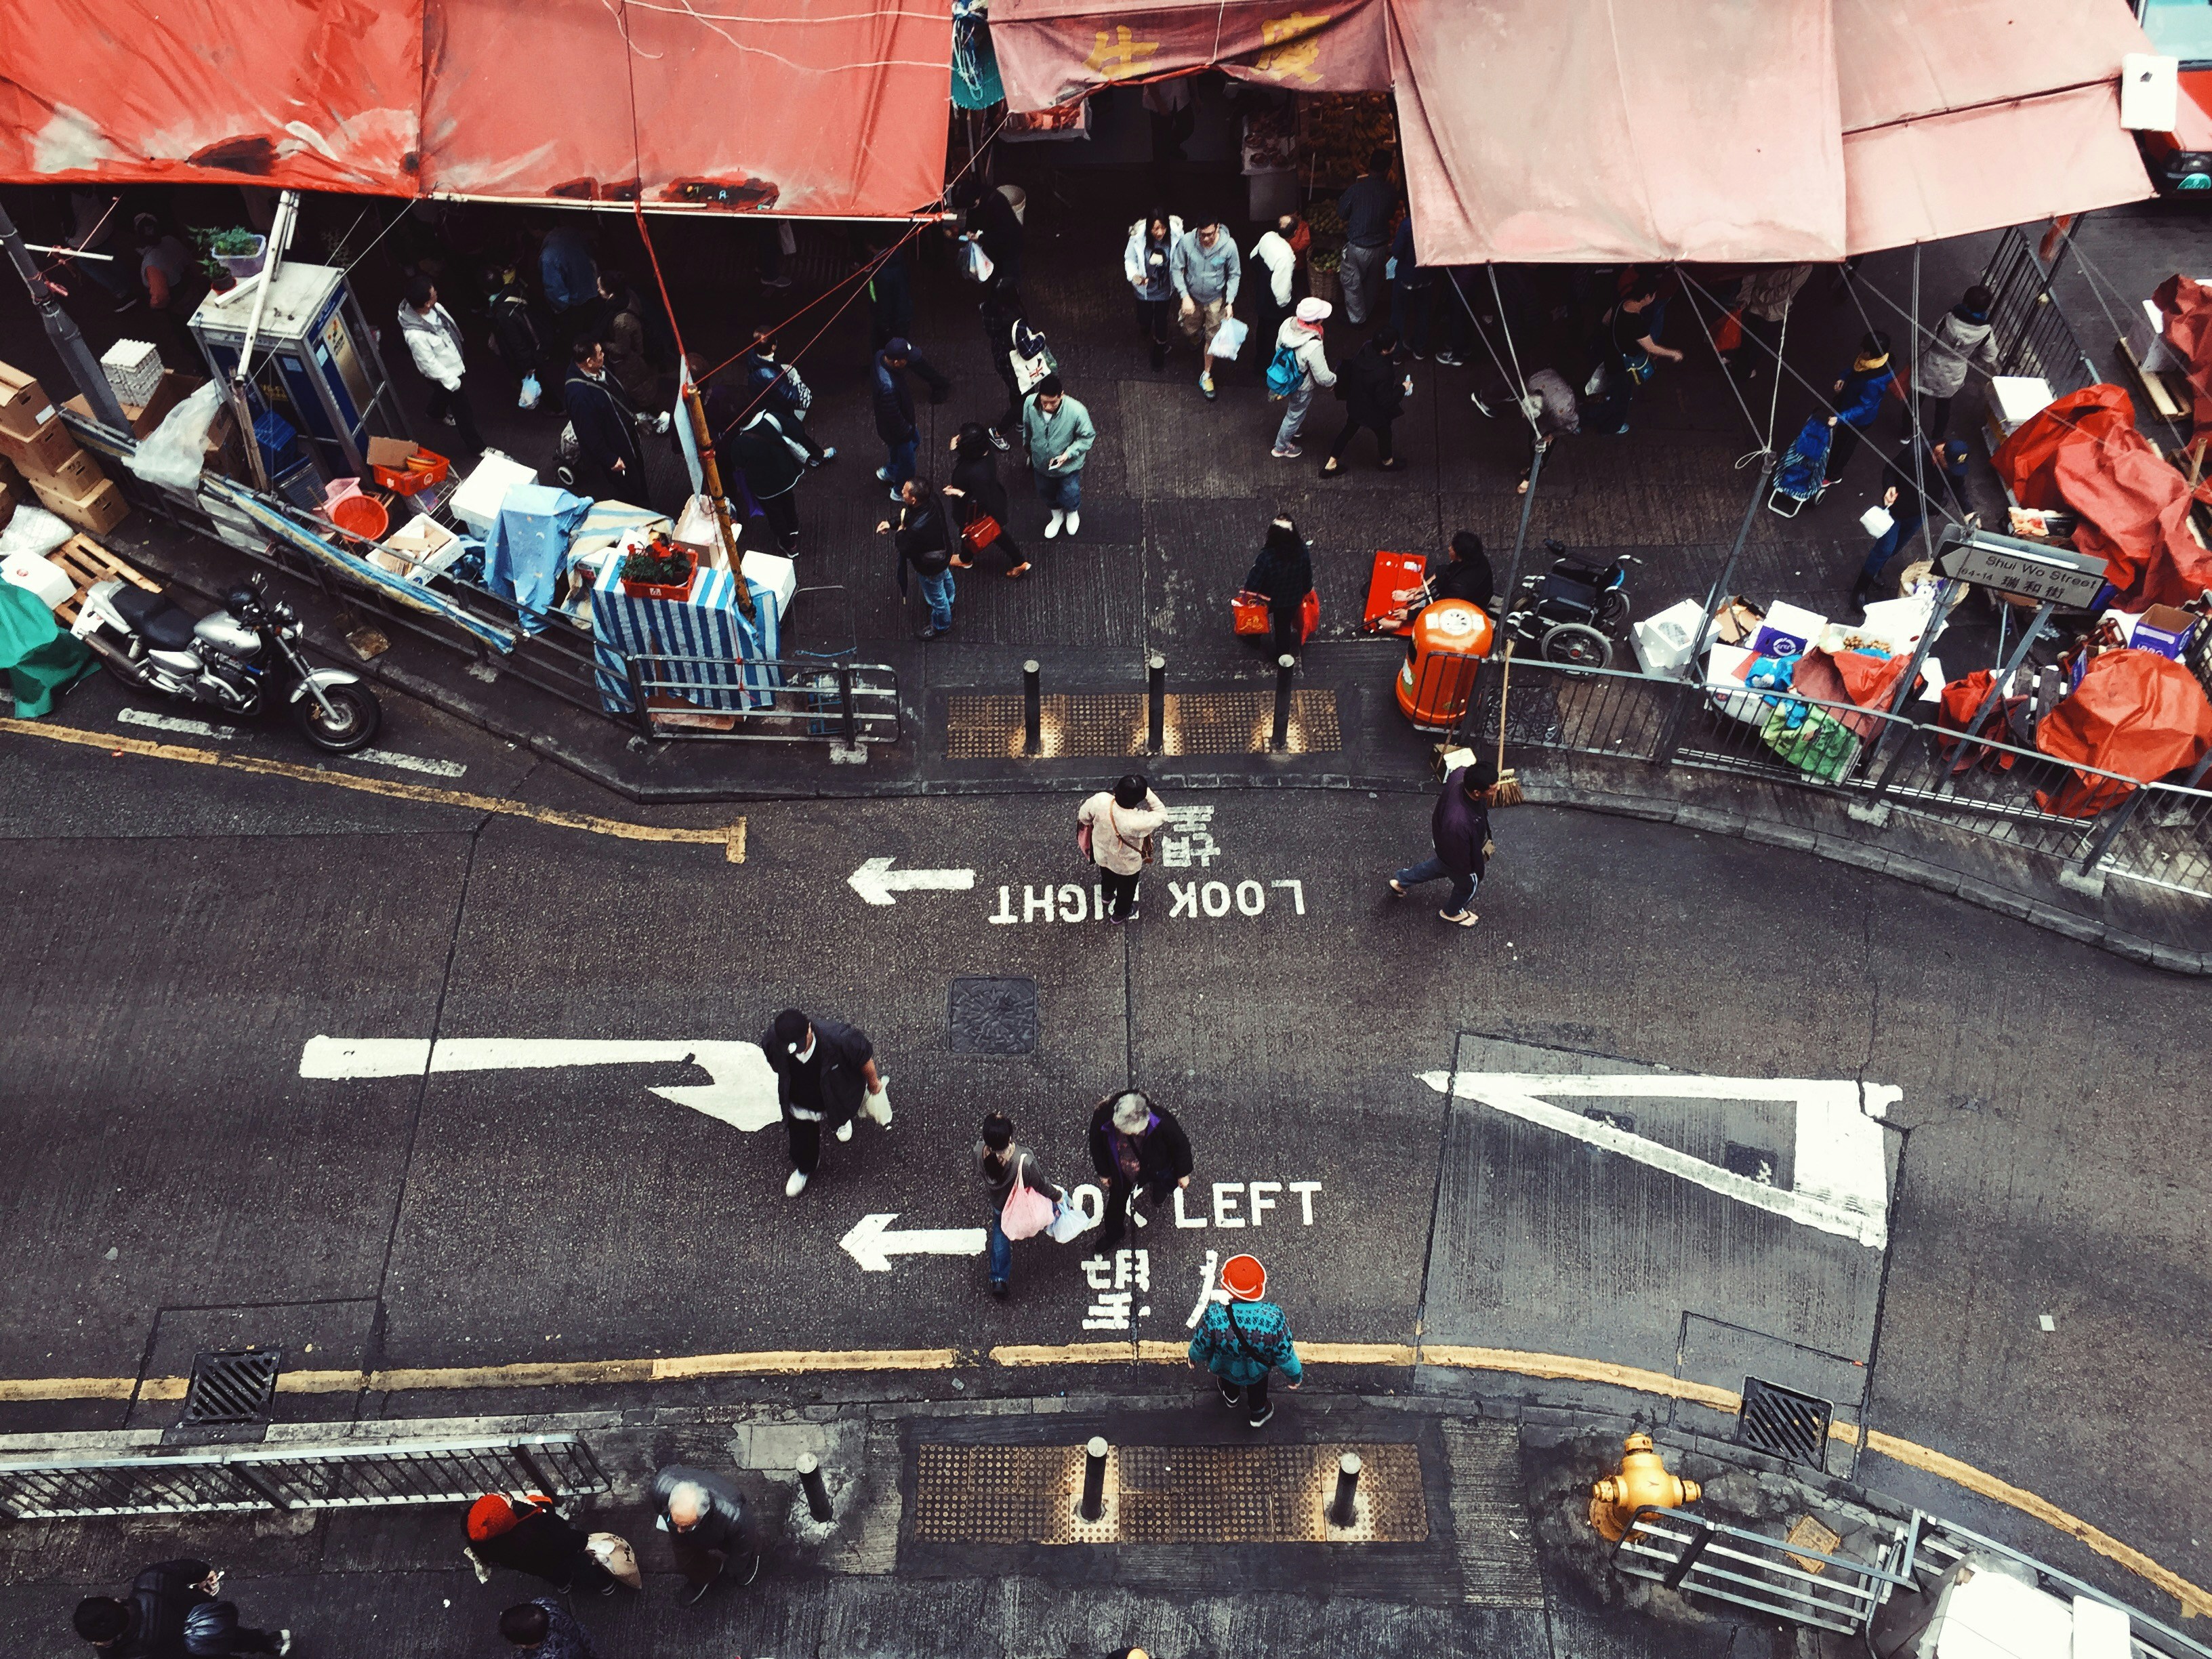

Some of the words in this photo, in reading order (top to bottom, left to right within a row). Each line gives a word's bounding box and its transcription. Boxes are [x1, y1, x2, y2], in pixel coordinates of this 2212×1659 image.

[1986, 555, 2017, 571] Shui
[2022, 563, 2045, 577] Wo
[2049, 570, 2097, 590] Street
[2000, 575, 2066, 599] 瑞和街
[1168, 879, 1305, 918] LOOK
[1173, 1181, 1323, 1229] LEFT
